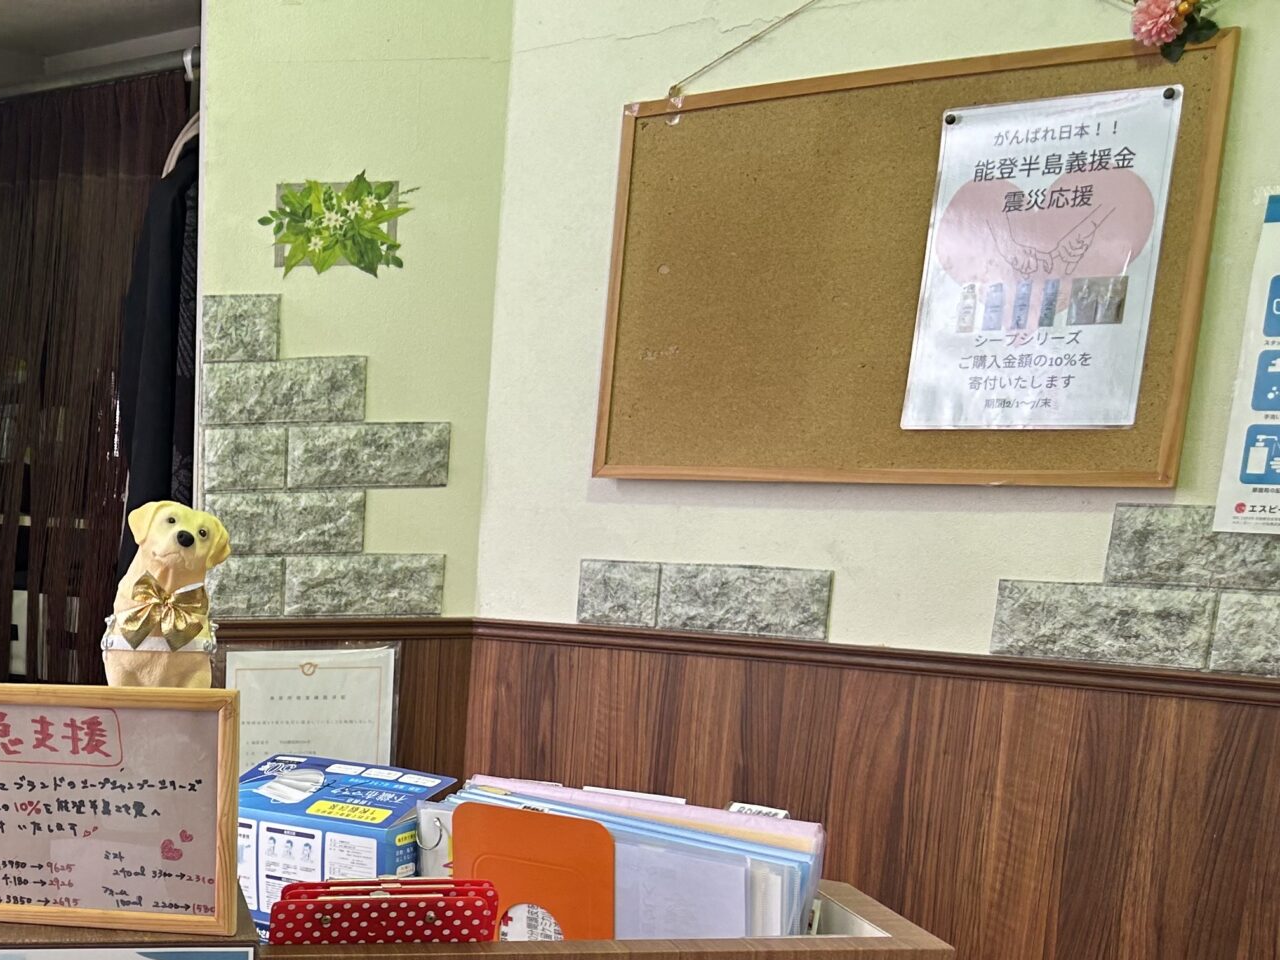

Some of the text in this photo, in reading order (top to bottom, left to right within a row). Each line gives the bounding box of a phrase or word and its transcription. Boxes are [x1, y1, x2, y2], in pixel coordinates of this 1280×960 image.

[973, 145, 1137, 183] 能登半島義援金
[1001, 184, 1094, 213] 震災応援
[958, 352, 1093, 371] ご購入金額の10%を
[968, 374, 1075, 391] 寄付いたします
[46, 862, 76, 874] 9625
[48, 877, 74, 890] 2926
[186, 874, 215, 885] 2310
[53, 897, 81, 908] 2695
